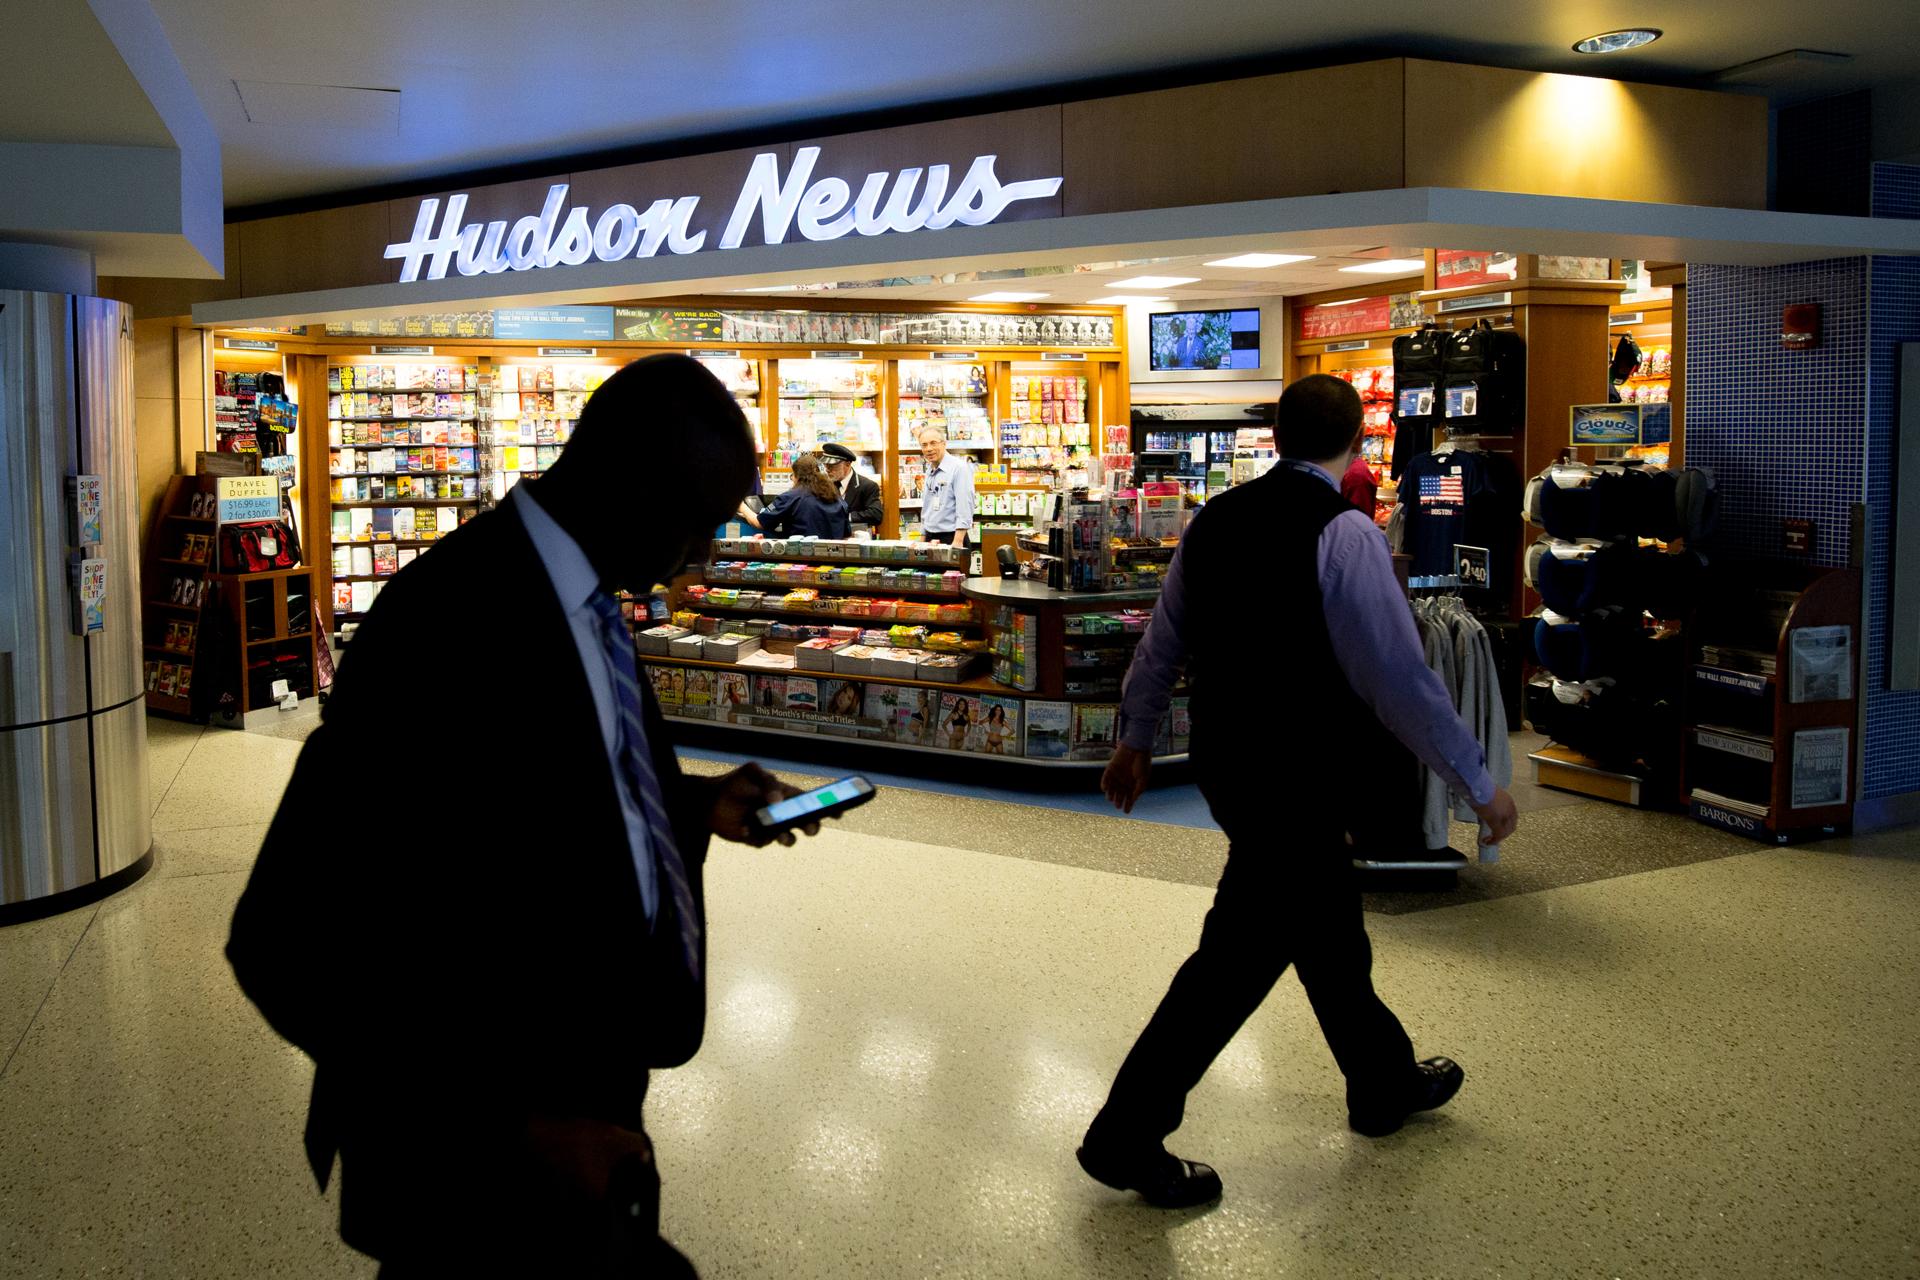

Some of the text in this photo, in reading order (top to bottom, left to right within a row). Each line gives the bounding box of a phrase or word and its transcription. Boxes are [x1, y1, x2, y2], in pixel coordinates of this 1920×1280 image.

[384, 146, 1064, 282] Hudson News
[80, 481, 99, 490] SHOP
[81, 492, 99, 501] DINE
[229, 489, 268, 497] DUFFEL
[228, 500, 253, 509] $16.99
[228, 512, 233, 520] 2
[247, 510, 271, 518] $30.00
[85, 564, 104, 573] SHOP
[84, 574, 103, 585] DINE
[83, 590, 98, 599] FLY!
[1706, 672, 1720, 682] WALL
[1720, 675, 1738, 685] STREET
[900, 688, 937, 701] SEF
[756, 706, 857, 725] This Month's Featured Titles
[1702, 734, 1769, 759] NEW YORK POST
[1700, 804, 1754, 831] BARRON'S
